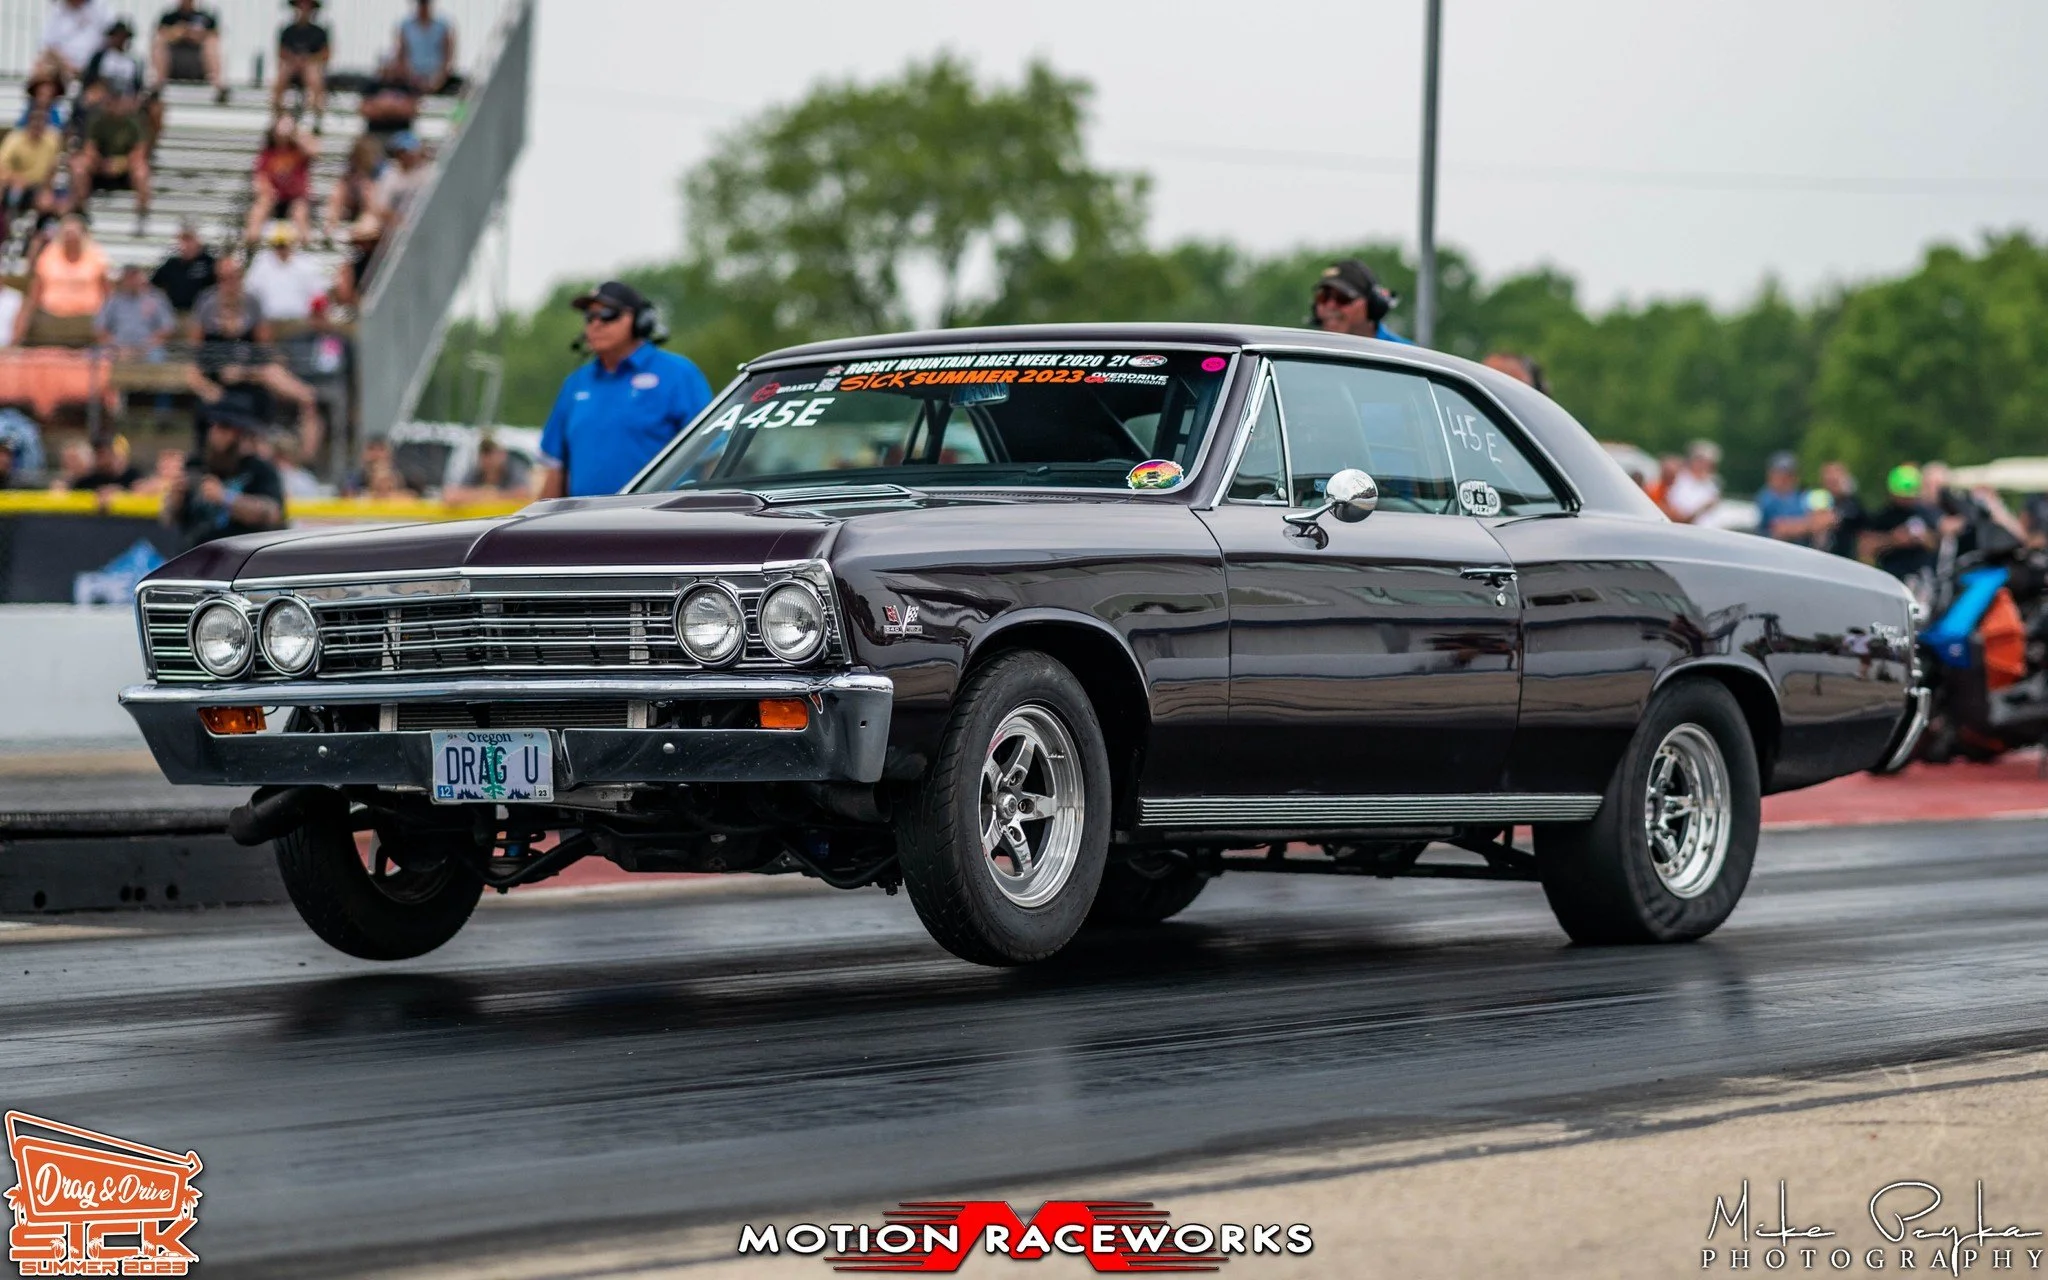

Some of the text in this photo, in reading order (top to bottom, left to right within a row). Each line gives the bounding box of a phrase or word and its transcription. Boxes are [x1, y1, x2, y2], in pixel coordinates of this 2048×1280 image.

[844, 360, 899, 375] ROCKY
[895, 355, 977, 371] MOUNTAIN
[973, 354, 1018, 368] RACE
[1015, 354, 1063, 367] WEEK
[1058, 354, 1105, 367] 2020
[1106, 354, 1131, 367] 21
[909, 370, 1019, 385] SUMMER
[1018, 369, 1085, 384] 2023
[1090, 371, 1170, 382] OVERDRIVE
[776, 382, 818, 394] BRAKES
[467, 731, 512, 746] Oregon
[445, 746, 539, 785] DRAG U
[440, 786, 451, 797] 12
[538, 789, 548, 797] 23
